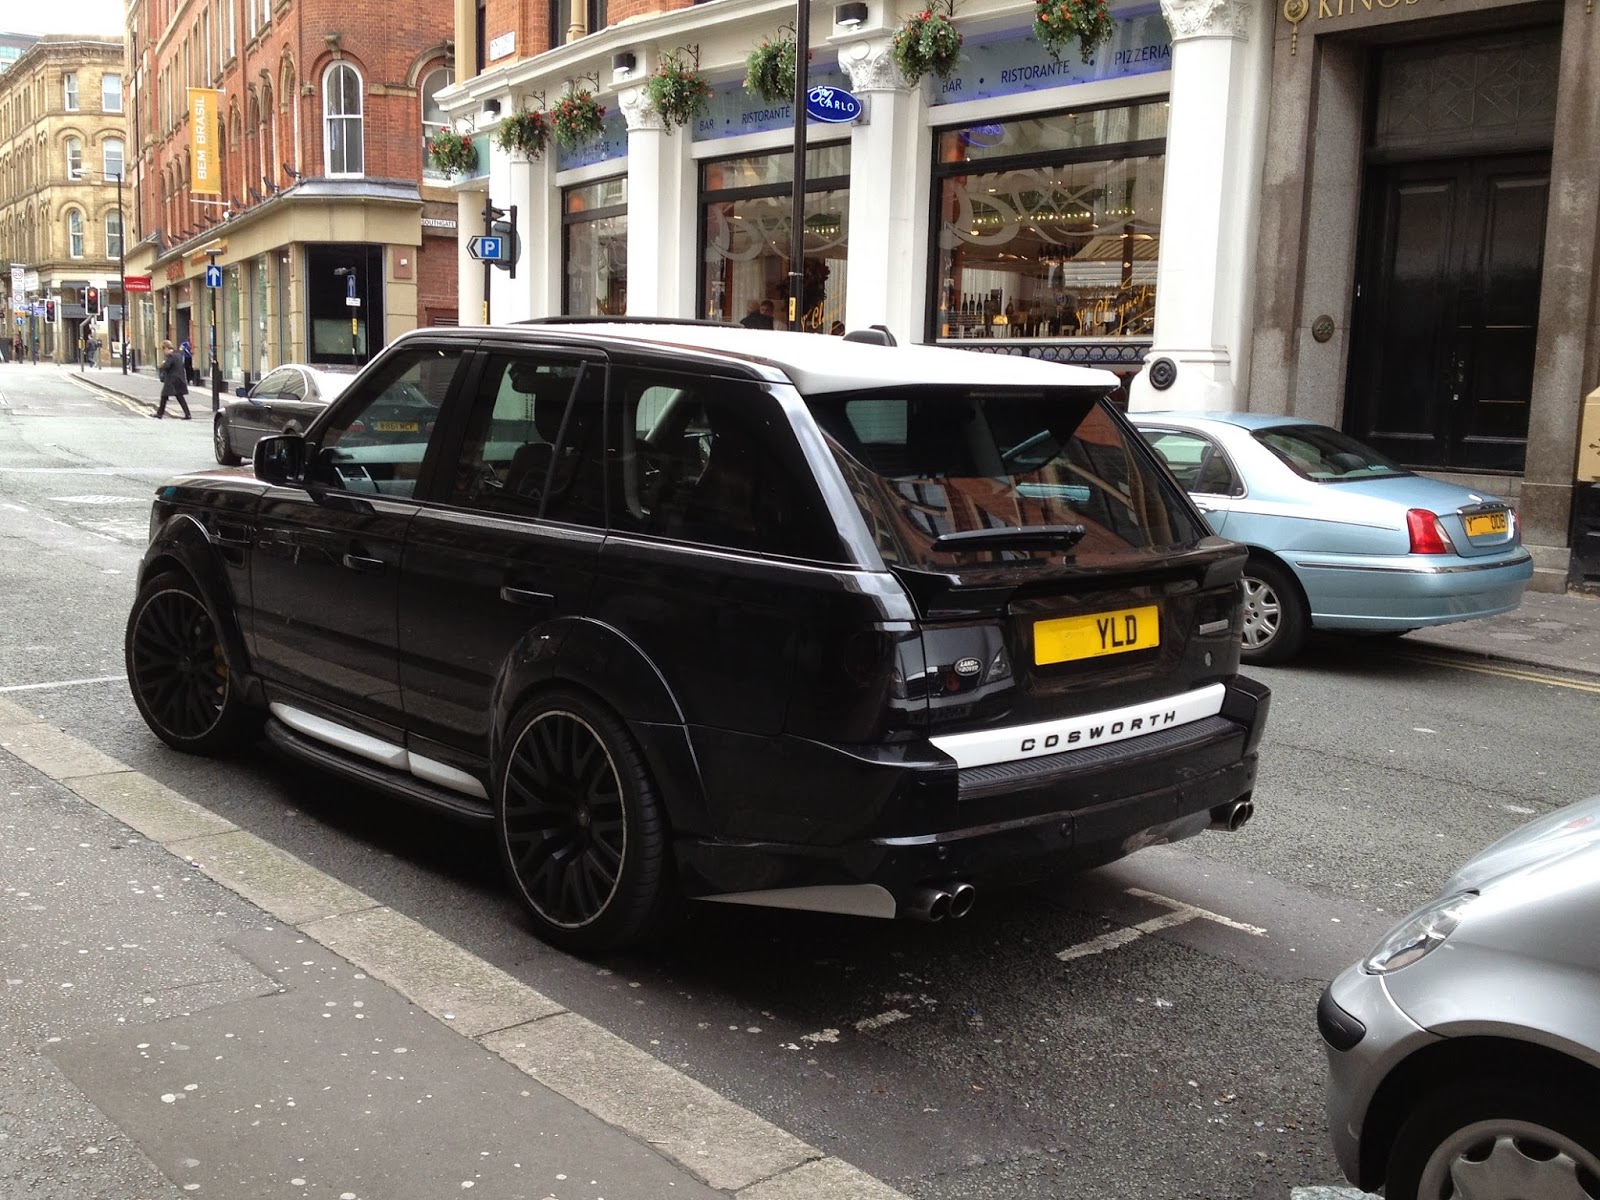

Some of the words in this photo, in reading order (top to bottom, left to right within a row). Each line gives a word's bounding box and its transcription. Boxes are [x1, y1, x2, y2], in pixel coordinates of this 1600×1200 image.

[942, 78, 962, 93] BAR
[1001, 60, 1070, 84] RISTORANTE
[1114, 44, 1170, 66] PIZZERIA
[699, 118, 714, 131] BAR
[741, 105, 791, 125] RISTORANTE
[819, 97, 855, 112] CARLO
[195, 95, 206, 145] BRASIL
[196, 149, 207, 180] BEM
[422, 219, 455, 227] SOUTHGATE
[484, 241, 496, 255] P
[1096, 614, 1138, 650] YLD
[960, 659, 976, 667] LAND
[1020, 710, 1176, 751] COSWORTH
